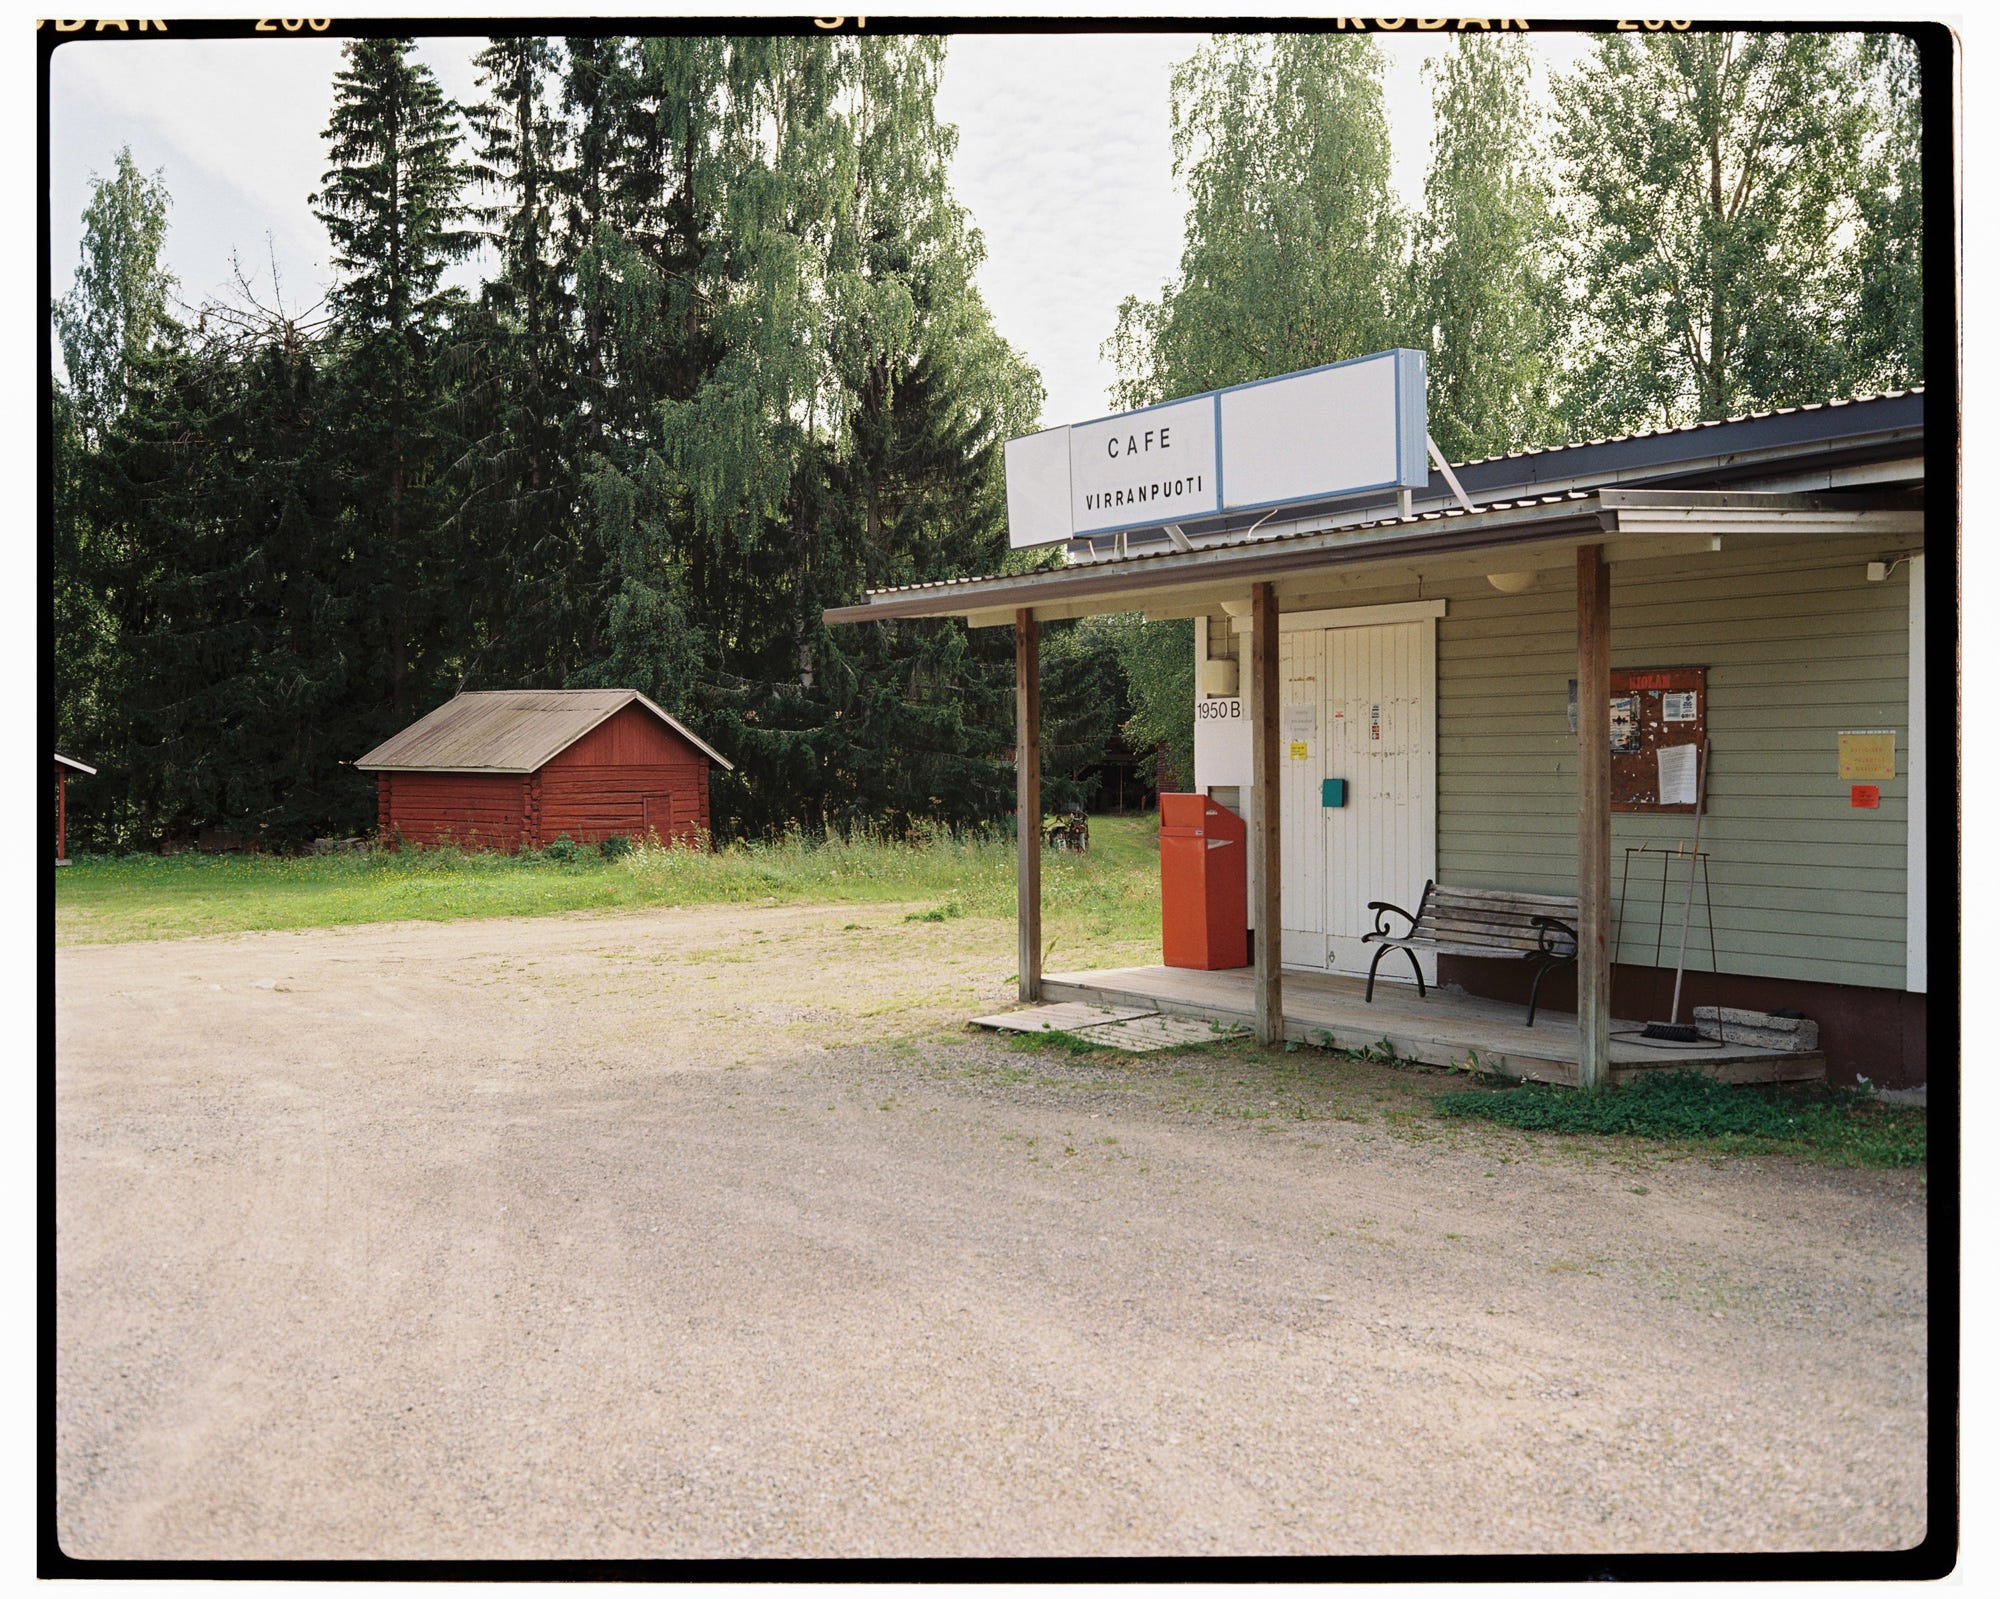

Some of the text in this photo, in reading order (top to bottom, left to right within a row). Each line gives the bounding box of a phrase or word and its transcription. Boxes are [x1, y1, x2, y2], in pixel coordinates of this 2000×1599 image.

[1108, 427, 1170, 458] CAFE
[1086, 475, 1201, 511] VIRRANPUOTI
[1197, 701, 1241, 719] 1950 B
